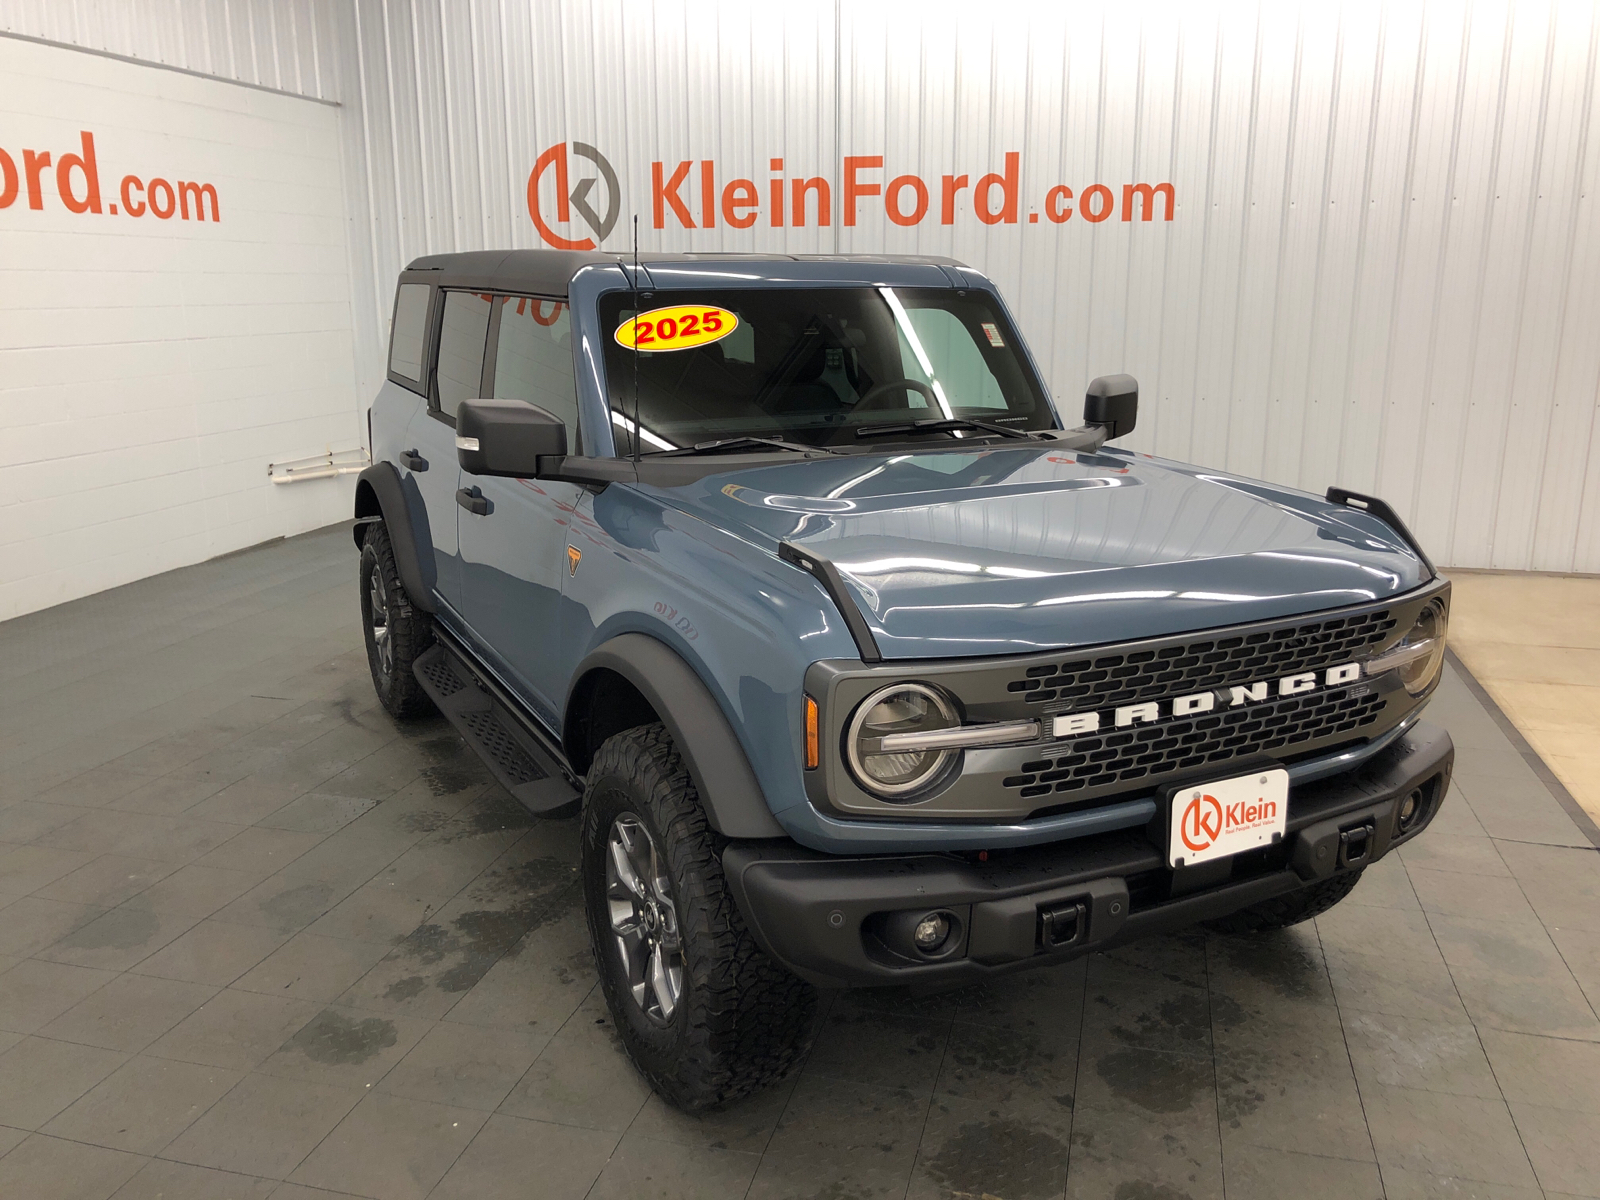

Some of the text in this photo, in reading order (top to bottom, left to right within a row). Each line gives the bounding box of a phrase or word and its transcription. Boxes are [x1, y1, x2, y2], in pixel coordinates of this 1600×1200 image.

[651, 152, 1176, 230] KleinFord.com
[633, 310, 723, 346] 2025
[1053, 662, 1360, 737] BRONCO
[1225, 797, 1277, 828] Klein
